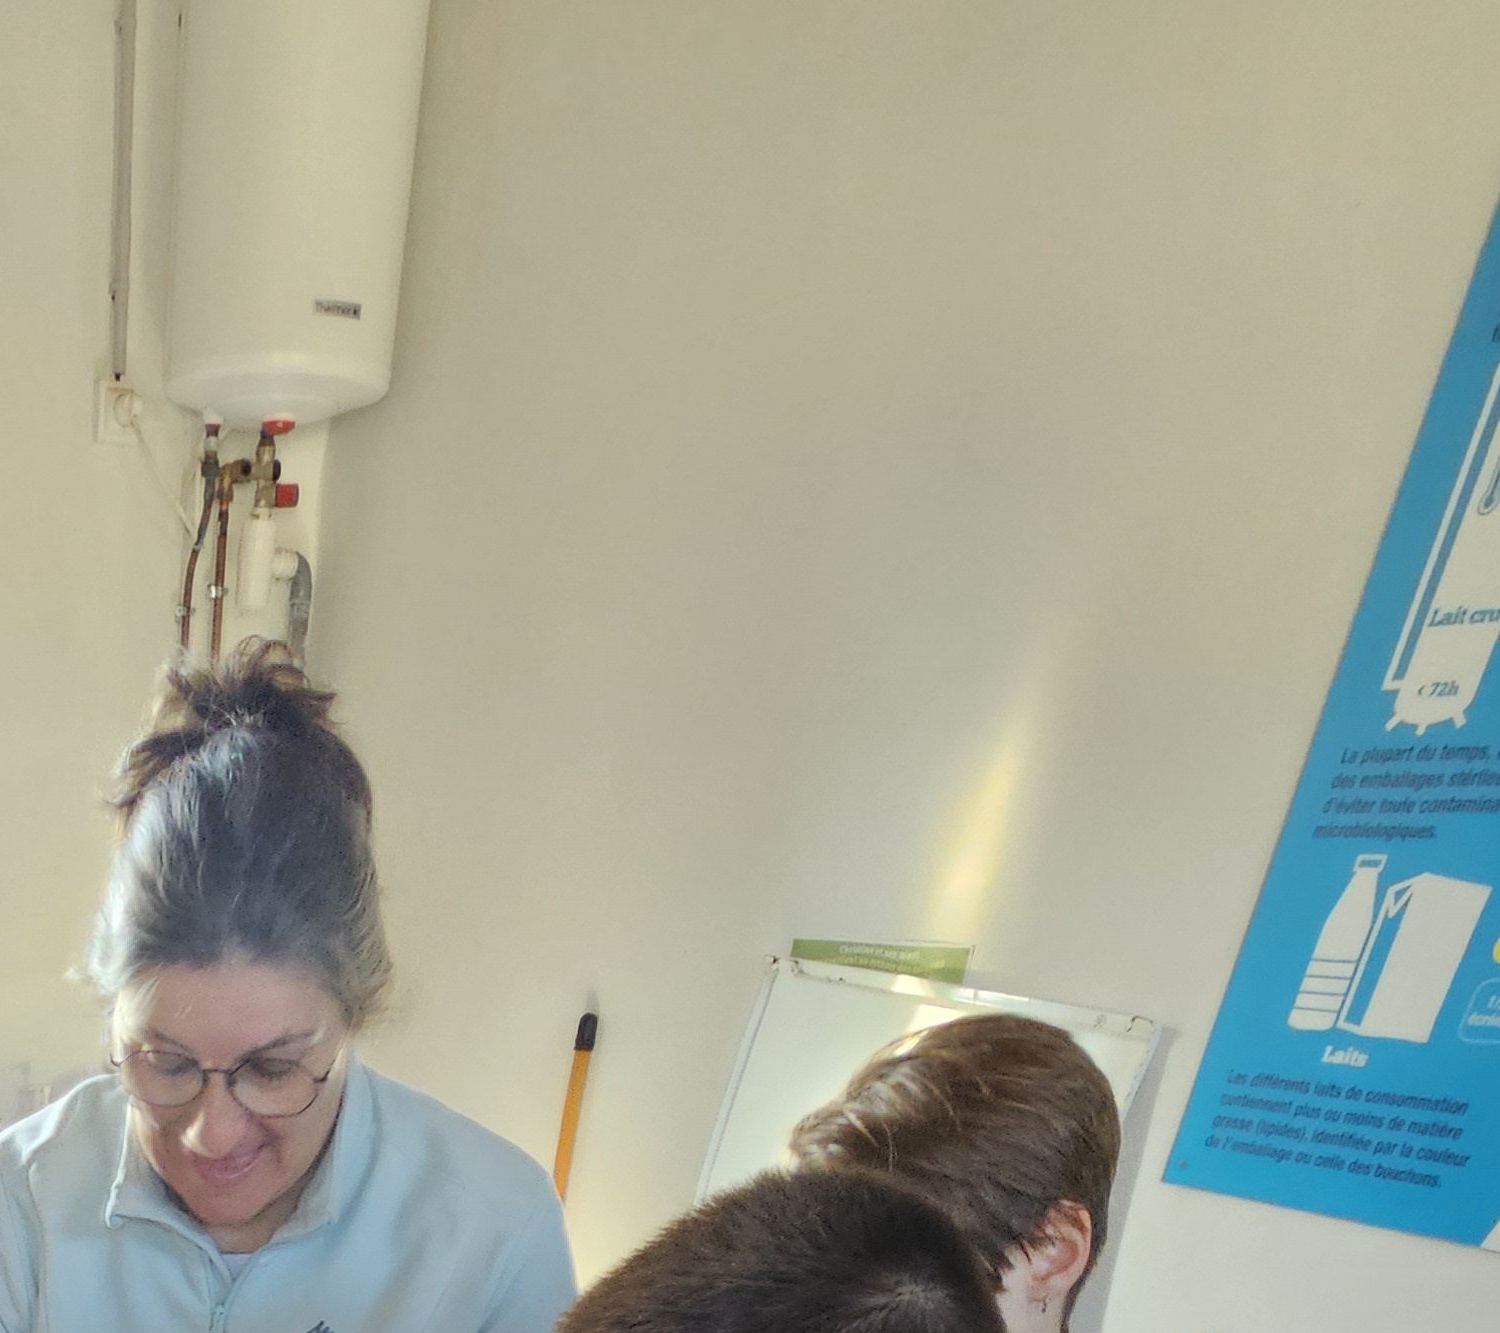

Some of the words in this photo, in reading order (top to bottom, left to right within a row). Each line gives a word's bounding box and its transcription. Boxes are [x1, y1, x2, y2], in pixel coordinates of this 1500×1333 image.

[1428, 606, 1467, 628] Lait
[1416, 744, 1438, 762] du
[1320, 1045, 1369, 1068] Laits
